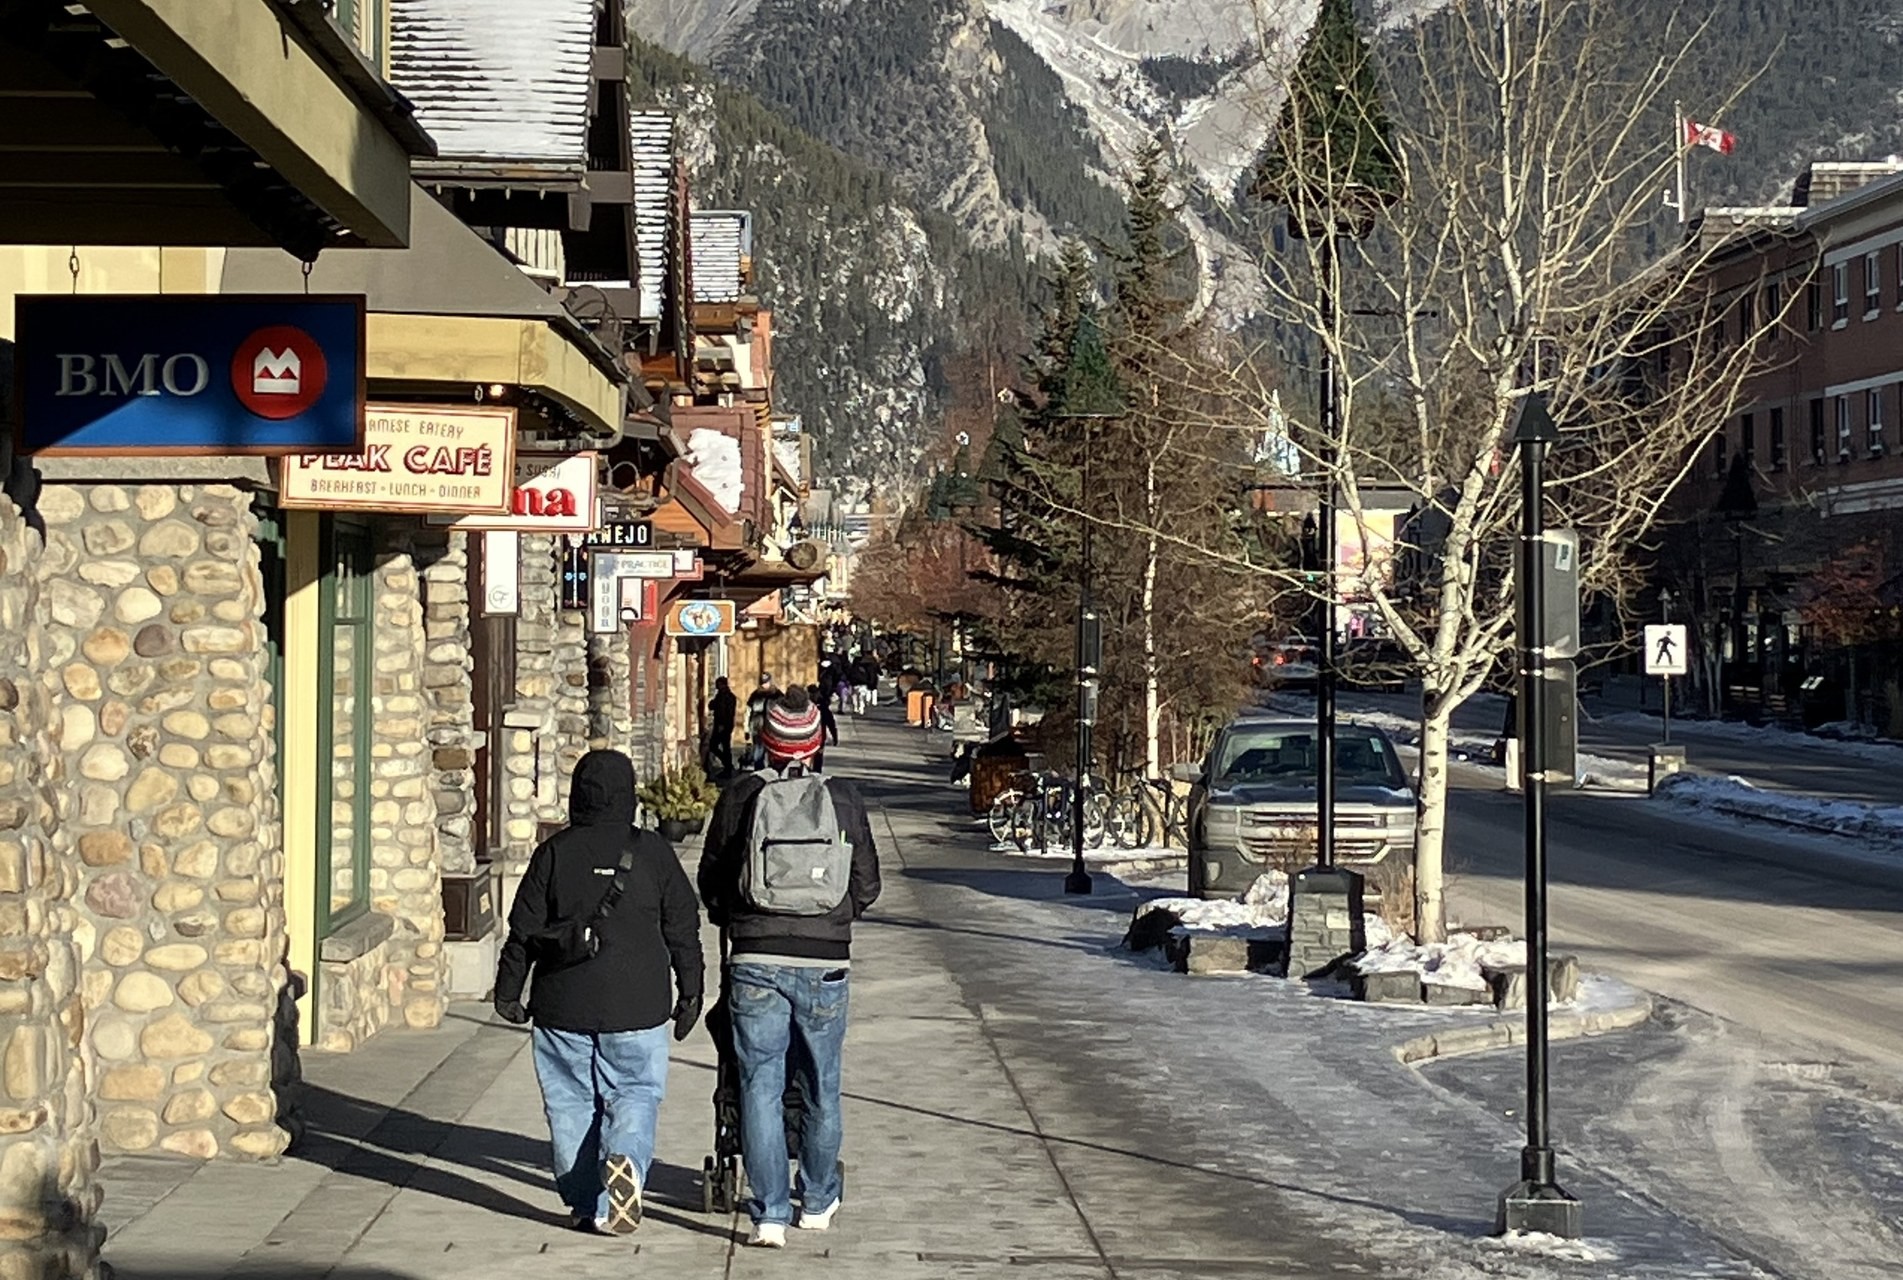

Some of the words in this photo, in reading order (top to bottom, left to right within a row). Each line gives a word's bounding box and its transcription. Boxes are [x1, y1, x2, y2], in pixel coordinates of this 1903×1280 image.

[55, 353, 209, 396] BMO
[419, 420, 465, 440] EATERY
[403, 443, 492, 476] CAFÉ
[310, 479, 376, 494] BREAKFAST
[389, 481, 427, 497] LUNCH
[438, 484, 482, 499] DINNER
[511, 485, 578, 517] na
